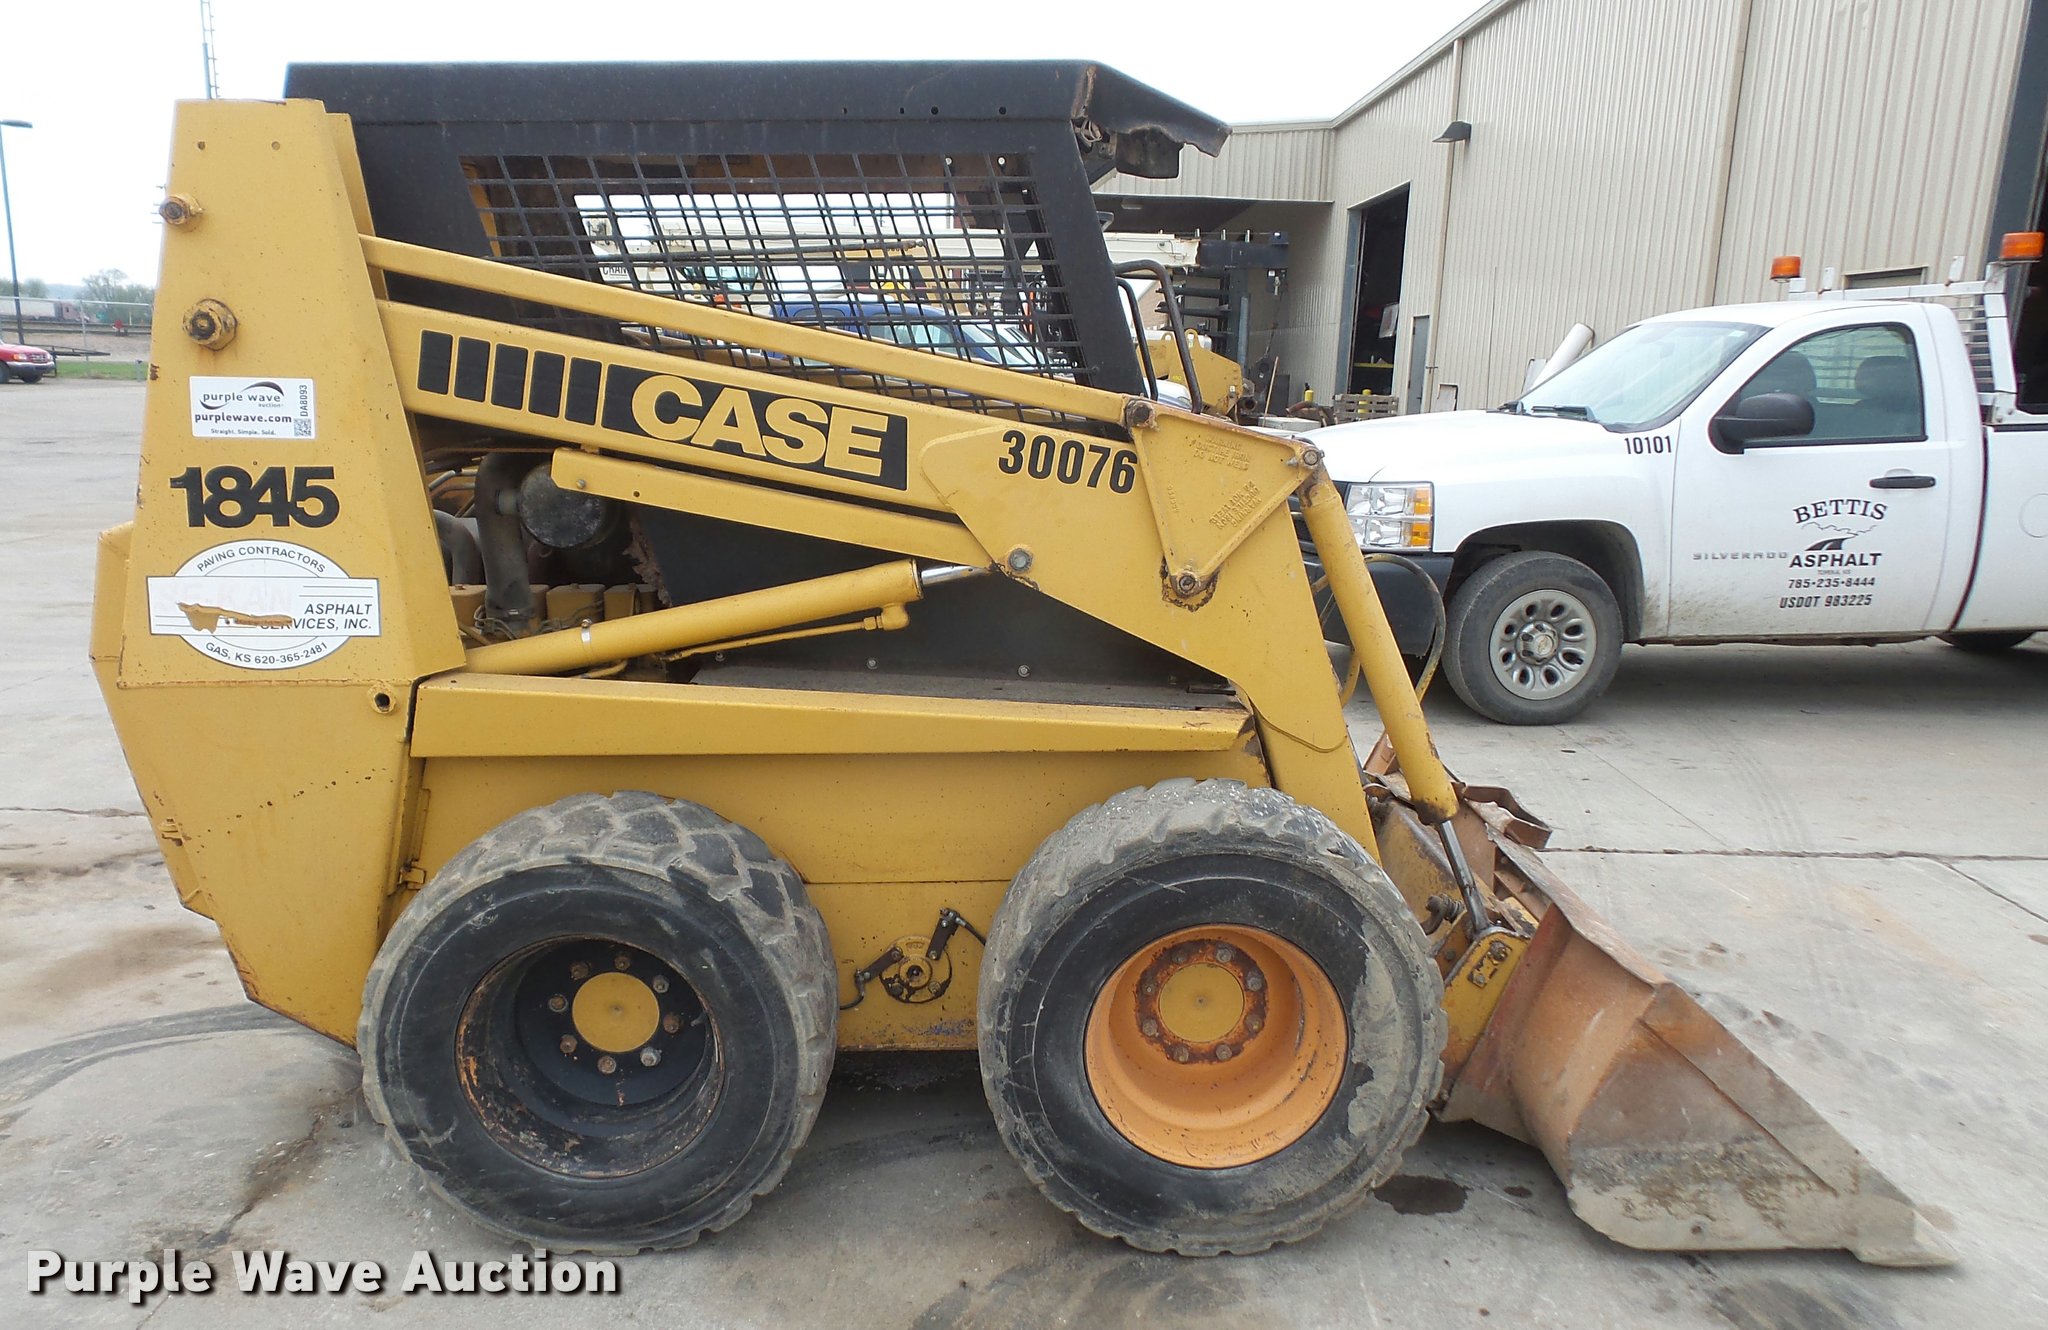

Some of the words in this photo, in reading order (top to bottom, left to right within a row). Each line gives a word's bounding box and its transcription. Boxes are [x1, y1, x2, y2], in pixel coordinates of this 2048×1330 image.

[203, 392, 243, 402] purple
[248, 394, 281, 402] wave
[195, 411, 292, 423] purplewave.com
[632, 374, 889, 477] CASE
[1624, 435, 1673, 455] 10101
[998, 430, 1138, 494] 30076
[170, 465, 340, 528] 1845
[1792, 499, 1888, 524] BETTIS
[196, 549, 235, 572] PAVING
[238, 546, 325, 573] CONTRACTORS
[1693, 552, 1789, 561] SILVERADO
[1789, 553, 1882, 568] ASPHALT
[304, 603, 372, 615] ASPHALT
[1779, 595, 1821, 609] USDOT
[1824, 594, 1872, 608] 983225
[344, 619, 372, 630] INC.
[205, 641, 231, 659] GAS,
[235, 652, 251, 663] KS
[254, 641, 328, 664] 620-365-2481
